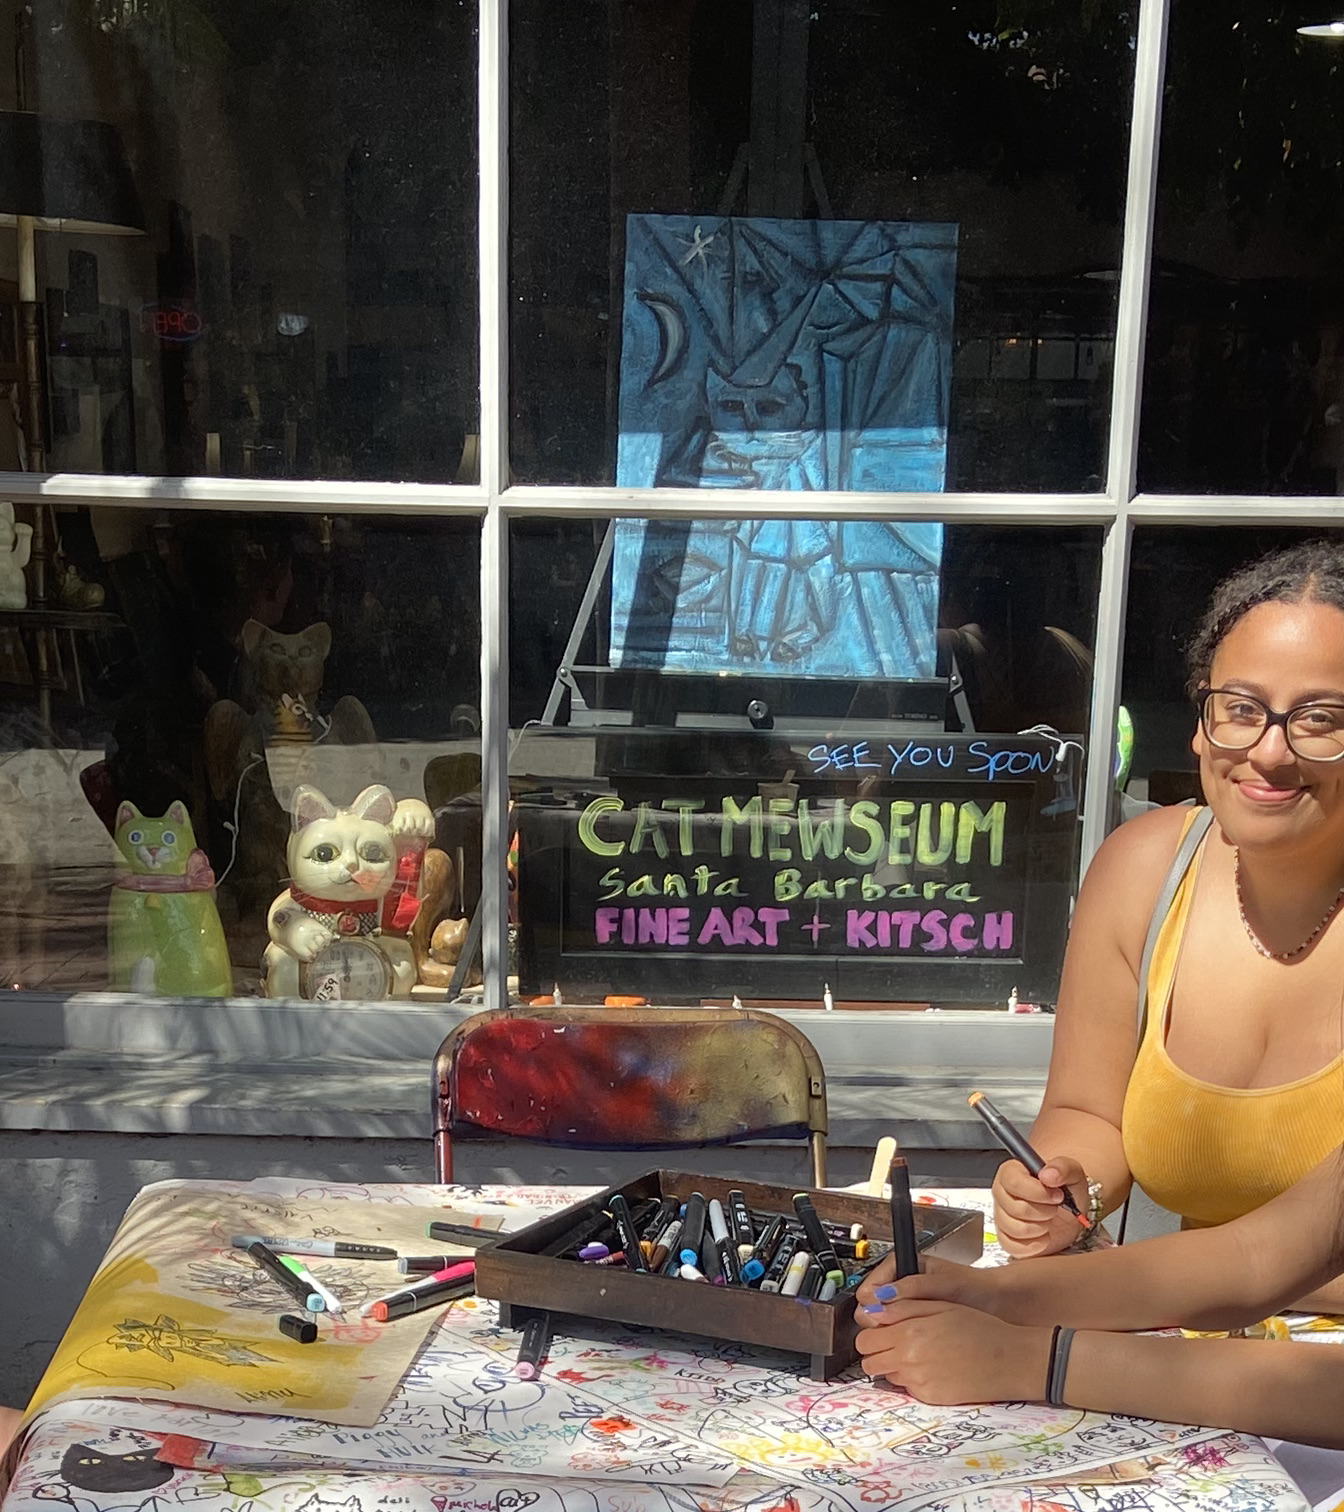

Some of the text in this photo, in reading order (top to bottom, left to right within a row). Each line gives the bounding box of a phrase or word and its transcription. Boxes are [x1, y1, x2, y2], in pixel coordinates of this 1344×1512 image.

[807, 741, 883, 774] SEE
[887, 741, 955, 780] YOU
[577, 795, 1007, 867] CAT MEWSEUM
[597, 864, 983, 903] Santa Barbara
[594, 906, 691, 946] FINE
[697, 906, 791, 948] ART
[845, 909, 1015, 952] KITSCH
